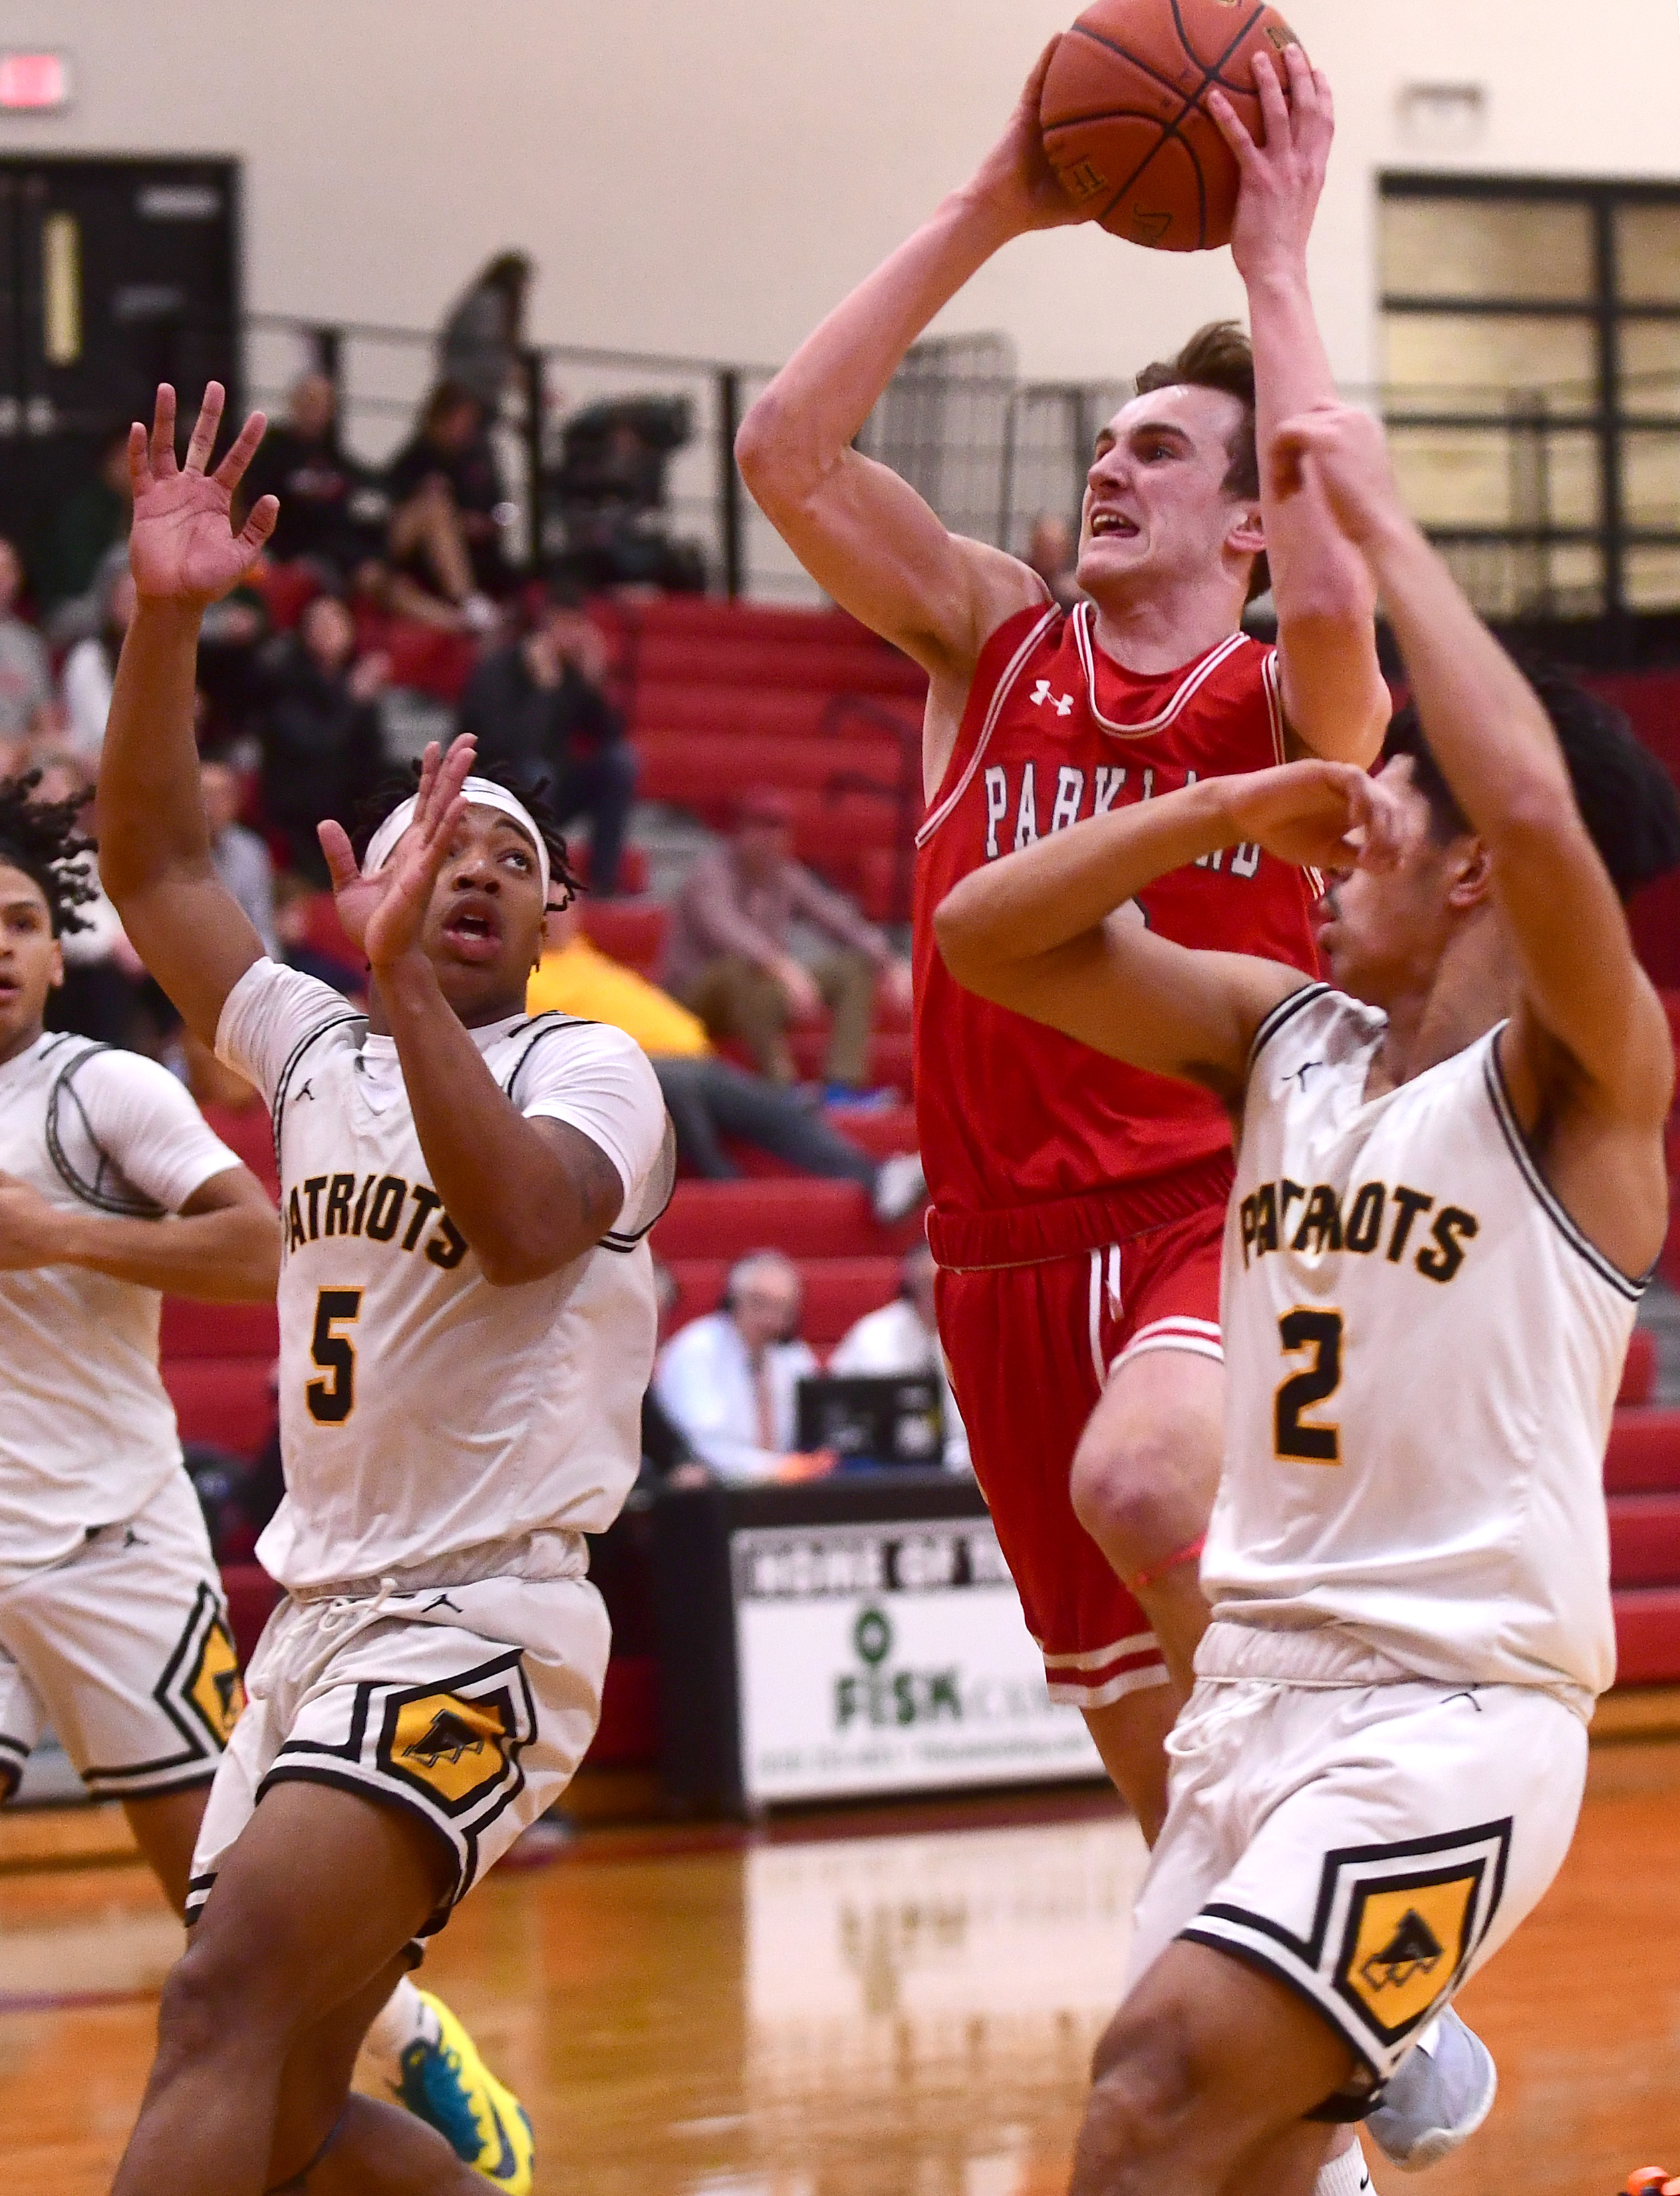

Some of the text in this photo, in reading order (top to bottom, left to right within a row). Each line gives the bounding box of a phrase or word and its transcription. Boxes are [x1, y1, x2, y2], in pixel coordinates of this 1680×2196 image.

[984, 761, 1262, 881] PARK
[283, 1172, 469, 1270] ATRIOTS
[304, 1284, 366, 1427] 5
[1274, 1304, 1344, 1466] 2
